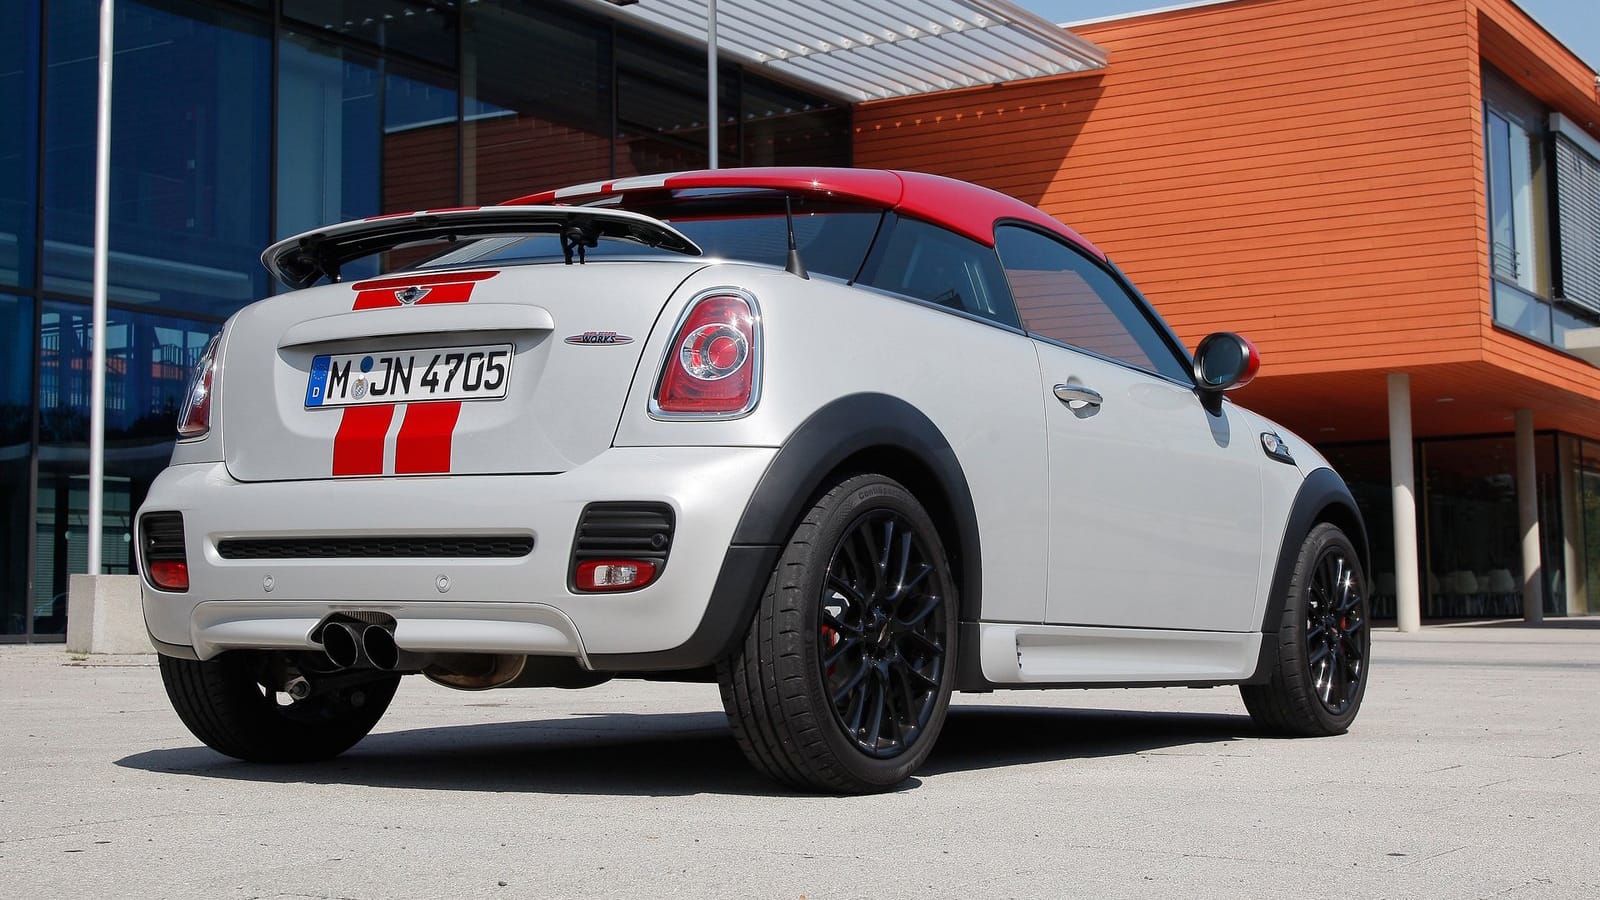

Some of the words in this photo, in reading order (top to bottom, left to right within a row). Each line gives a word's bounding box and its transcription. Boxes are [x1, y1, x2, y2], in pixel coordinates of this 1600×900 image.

[582, 335, 616, 343] WORKS
[327, 360, 352, 399] M
[369, 356, 415, 396] JN
[420, 351, 508, 393] 4705
[312, 387, 320, 398] D
